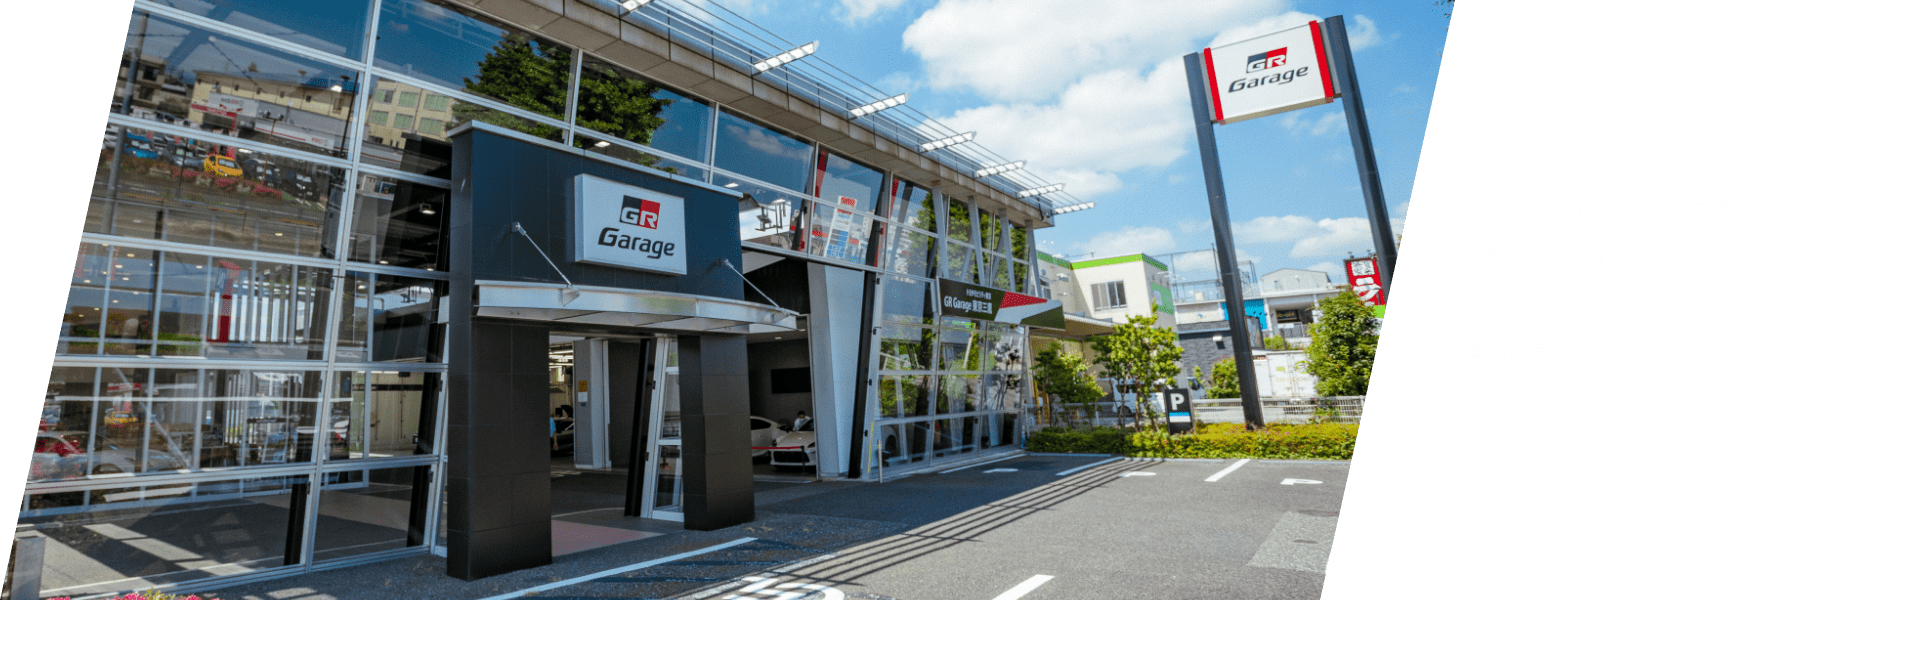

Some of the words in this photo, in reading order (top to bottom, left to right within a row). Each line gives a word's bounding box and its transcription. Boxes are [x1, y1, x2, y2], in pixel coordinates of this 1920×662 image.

[1246, 54, 1286, 73] GR
[1228, 66, 1309, 93] Garage
[620, 207, 658, 229] GR
[598, 227, 675, 259] Garage
[944, 295, 953, 307] GR
[953, 297, 972, 313] Garage
[1170, 393, 1185, 410] P
[1280, 478, 1323, 486] P
